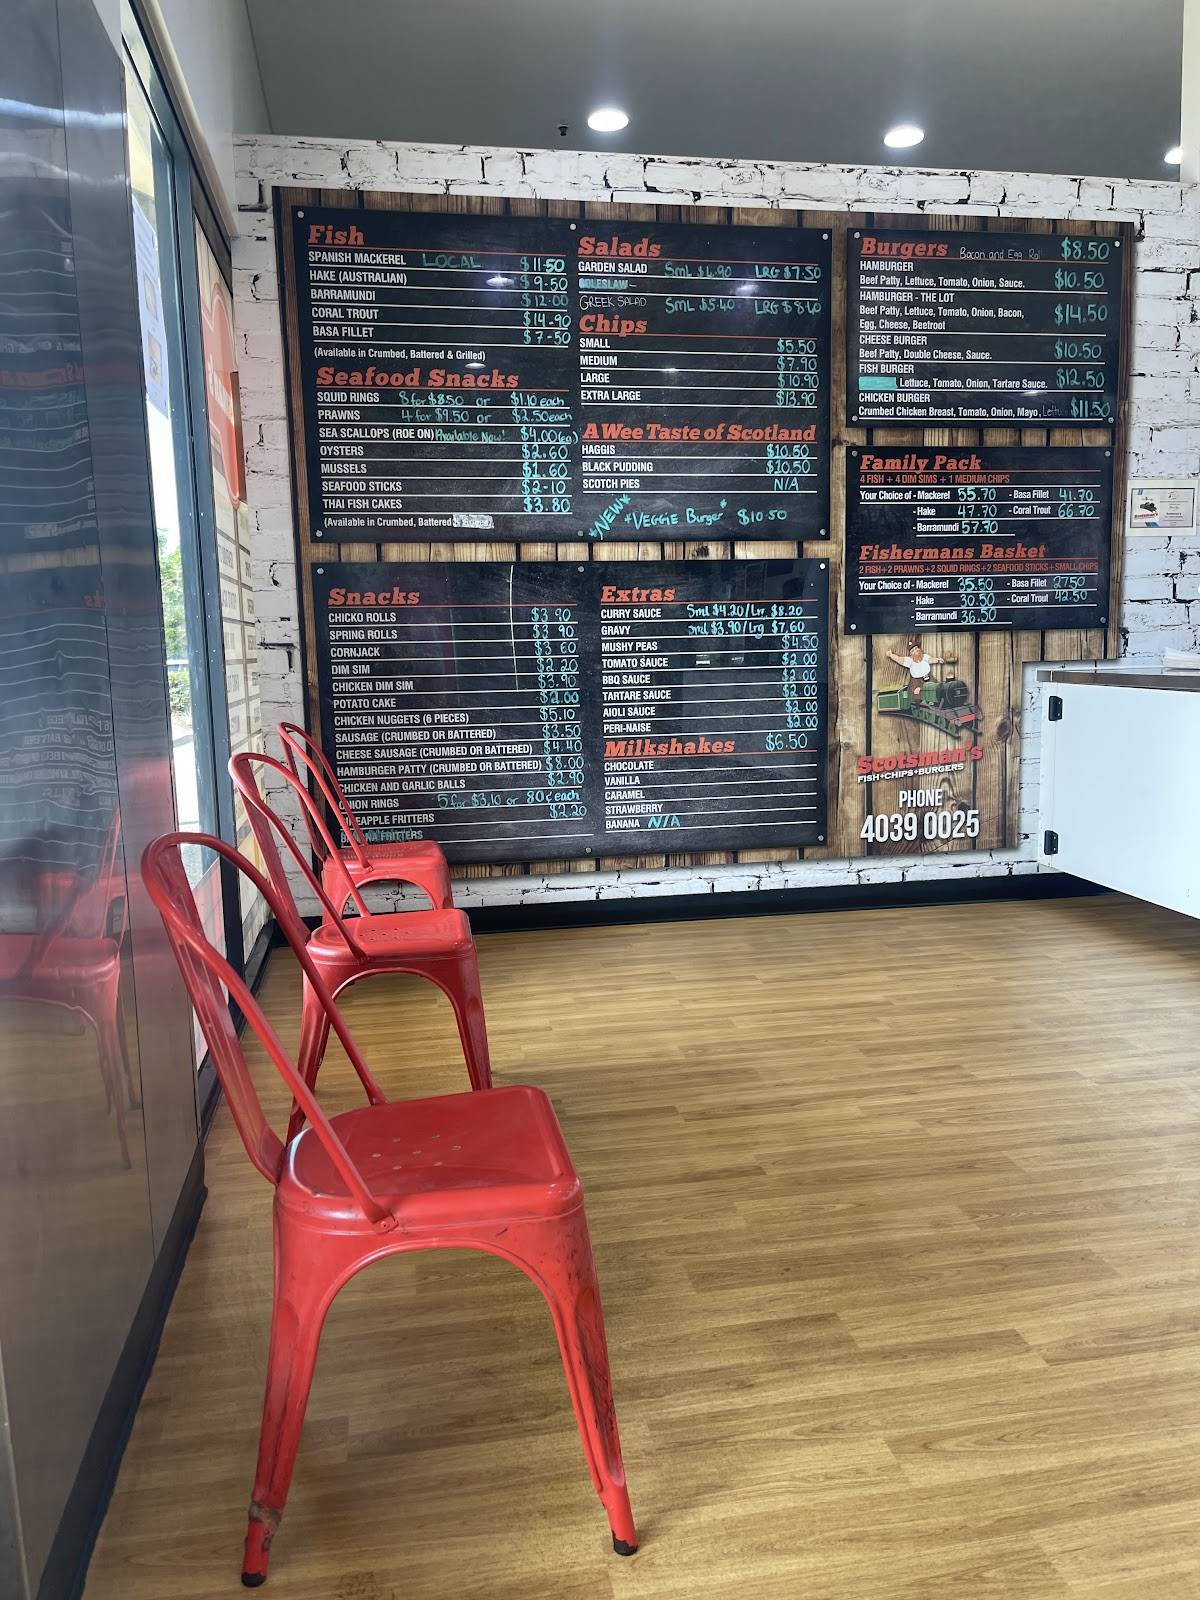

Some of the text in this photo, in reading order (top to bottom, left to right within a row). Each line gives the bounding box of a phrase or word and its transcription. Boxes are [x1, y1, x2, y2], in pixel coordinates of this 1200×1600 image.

[308, 224, 364, 246] Fish
[578, 236, 661, 257] Salads
[861, 238, 948, 259] Burgers
[1061, 237, 1110, 261] $8.50
[308, 251, 407, 265] SPANISH MACKEREL
[422, 254, 482, 268] LOCAL
[578, 262, 647, 273] GARDEN SALAD
[860, 261, 913, 271] HAMBURGER
[310, 271, 407, 284] HAKE (AUSTRALIAN)
[1054, 268, 1104, 291] $10.50
[311, 289, 376, 301] BARRAMUNDI
[860, 291, 913, 301] HAMBURGER
[580, 295, 647, 310] GREEK SALAD
[311, 308, 378, 319] CORAL TROUT
[1054, 304, 1108, 325] $14.50
[579, 314, 648, 336] Chips
[912, 320, 945, 330] Beetroot
[313, 326, 374, 337] BASA FILLET
[580, 338, 610, 348] SMALL
[776, 338, 816, 353] $5.50
[860, 335, 927, 346] CHEESE BURGER
[314, 348, 486, 361] (Available Grilled)
[1054, 339, 1102, 359] $10.50
[904, 350, 931, 360] Double
[580, 356, 617, 366] MEDIUM
[776, 356, 817, 371] $7.90
[880, 364, 914, 374] BURGER
[316, 367, 519, 388] Seafood Snacks
[581, 373, 610, 383] LARGE
[777, 373, 819, 388] $10.90
[1056, 368, 1105, 389] $12.50
[993, 379, 1020, 389] Tartare
[317, 392, 379, 402] SQUID RINGS
[581, 391, 640, 400] EXTRA LARGE
[776, 391, 815, 406] $13.90
[859, 393, 930, 403] CHICKEN BURGER
[859, 407, 927, 417] Crumbed Chicken
[1070, 397, 1110, 417] $11.50
[318, 410, 360, 420] PRAWNS
[319, 428, 389, 439] SEA SCALLOPS
[647, 423, 816, 441] Taste Scotland
[320, 446, 364, 456] OYSTERS
[582, 445, 615, 454] HAGGIS
[321, 464, 367, 474] MUSSELS
[582, 462, 653, 472] BLACK PUDDING
[860, 454, 981, 473] Family Pack
[583, 479, 640, 489] SCOTCH PIES
[773, 477, 799, 491] N/A
[955, 475, 1010, 483] MEDIUM CHIPS
[322, 481, 402, 492] SEAFOOD STICKS
[879, 490, 950, 500] Choice Mackerel
[958, 487, 997, 500] 55.70
[1014, 490, 1049, 499] Basa Fillet
[323, 499, 402, 509] THAI FISH CAKES
[524, 497, 570, 513] $3.80
[917, 507, 936, 516] Hake
[1013, 506, 1051, 515] Coral Trout
[324, 517, 365, 528] (Available
[917, 522, 959, 532] Barramundi
[860, 543, 1046, 560] Fishermans Basket
[937, 564, 957, 572] SQUID
[959, 564, 980, 572] RINGS
[993, 563, 1023, 572] SEAFOOD
[1025, 563, 1048, 571] STICKS
[878, 580, 948, 590] Choice Mackerel
[1012, 579, 1029, 588] Basa
[328, 587, 420, 606] Snacks
[601, 585, 676, 602] Extras
[1012, 594, 1029, 603] Coral
[916, 596, 934, 605] Hake
[601, 608, 662, 619] CURRY SAUCE
[771, 605, 803, 618] $8.20
[916, 611, 958, 621] Barramundi
[329, 612, 396, 623] CHICKO ROLLS
[329, 630, 398, 640] SPRING ROLLS
[601, 626, 631, 636] GRAVY
[602, 642, 658, 652] MUSHY PEAS
[782, 634, 818, 650] $4.50
[330, 647, 380, 658] CORNJACK
[602, 658, 668, 668] TOMATO SAUCE
[331, 665, 370, 674] DIM SIM
[622, 675, 650, 684] SAUCE
[332, 682, 373, 692] CHICKEN
[603, 690, 671, 701] TARTARE SAUCE
[334, 698, 396, 709] POTATO CAKE
[540, 706, 575, 721] $5.10
[603, 707, 655, 717] AIOLI SAUCE
[334, 714, 420, 725] CHICKEN NUGGETS
[542, 723, 581, 738] $3.50
[604, 723, 651, 733] PERI-NAISE
[335, 732, 378, 743] SAUSAGE
[765, 732, 808, 751] $6.50
[605, 737, 736, 757] Milkshakes
[336, 748, 417, 760] CHEESE SAUSAGE
[857, 740, 984, 774] Scotsman's
[337, 764, 427, 777] HAMBURGER PATTY
[605, 761, 654, 772] CHOCOLATE
[402, 779, 466, 791] GARLIC BALLS
[605, 776, 640, 786] VANILLA
[605, 791, 645, 800] CARAMEL
[899, 789, 943, 808] PHONE
[368, 798, 399, 808] RINGS
[550, 804, 587, 820] $2.20
[606, 804, 663, 815] STRAWBERRY
[392, 813, 434, 824] FRITTERS
[606, 819, 640, 829] BANANA
[647, 816, 681, 828] N/A
[860, 810, 980, 843] 4039 0025
